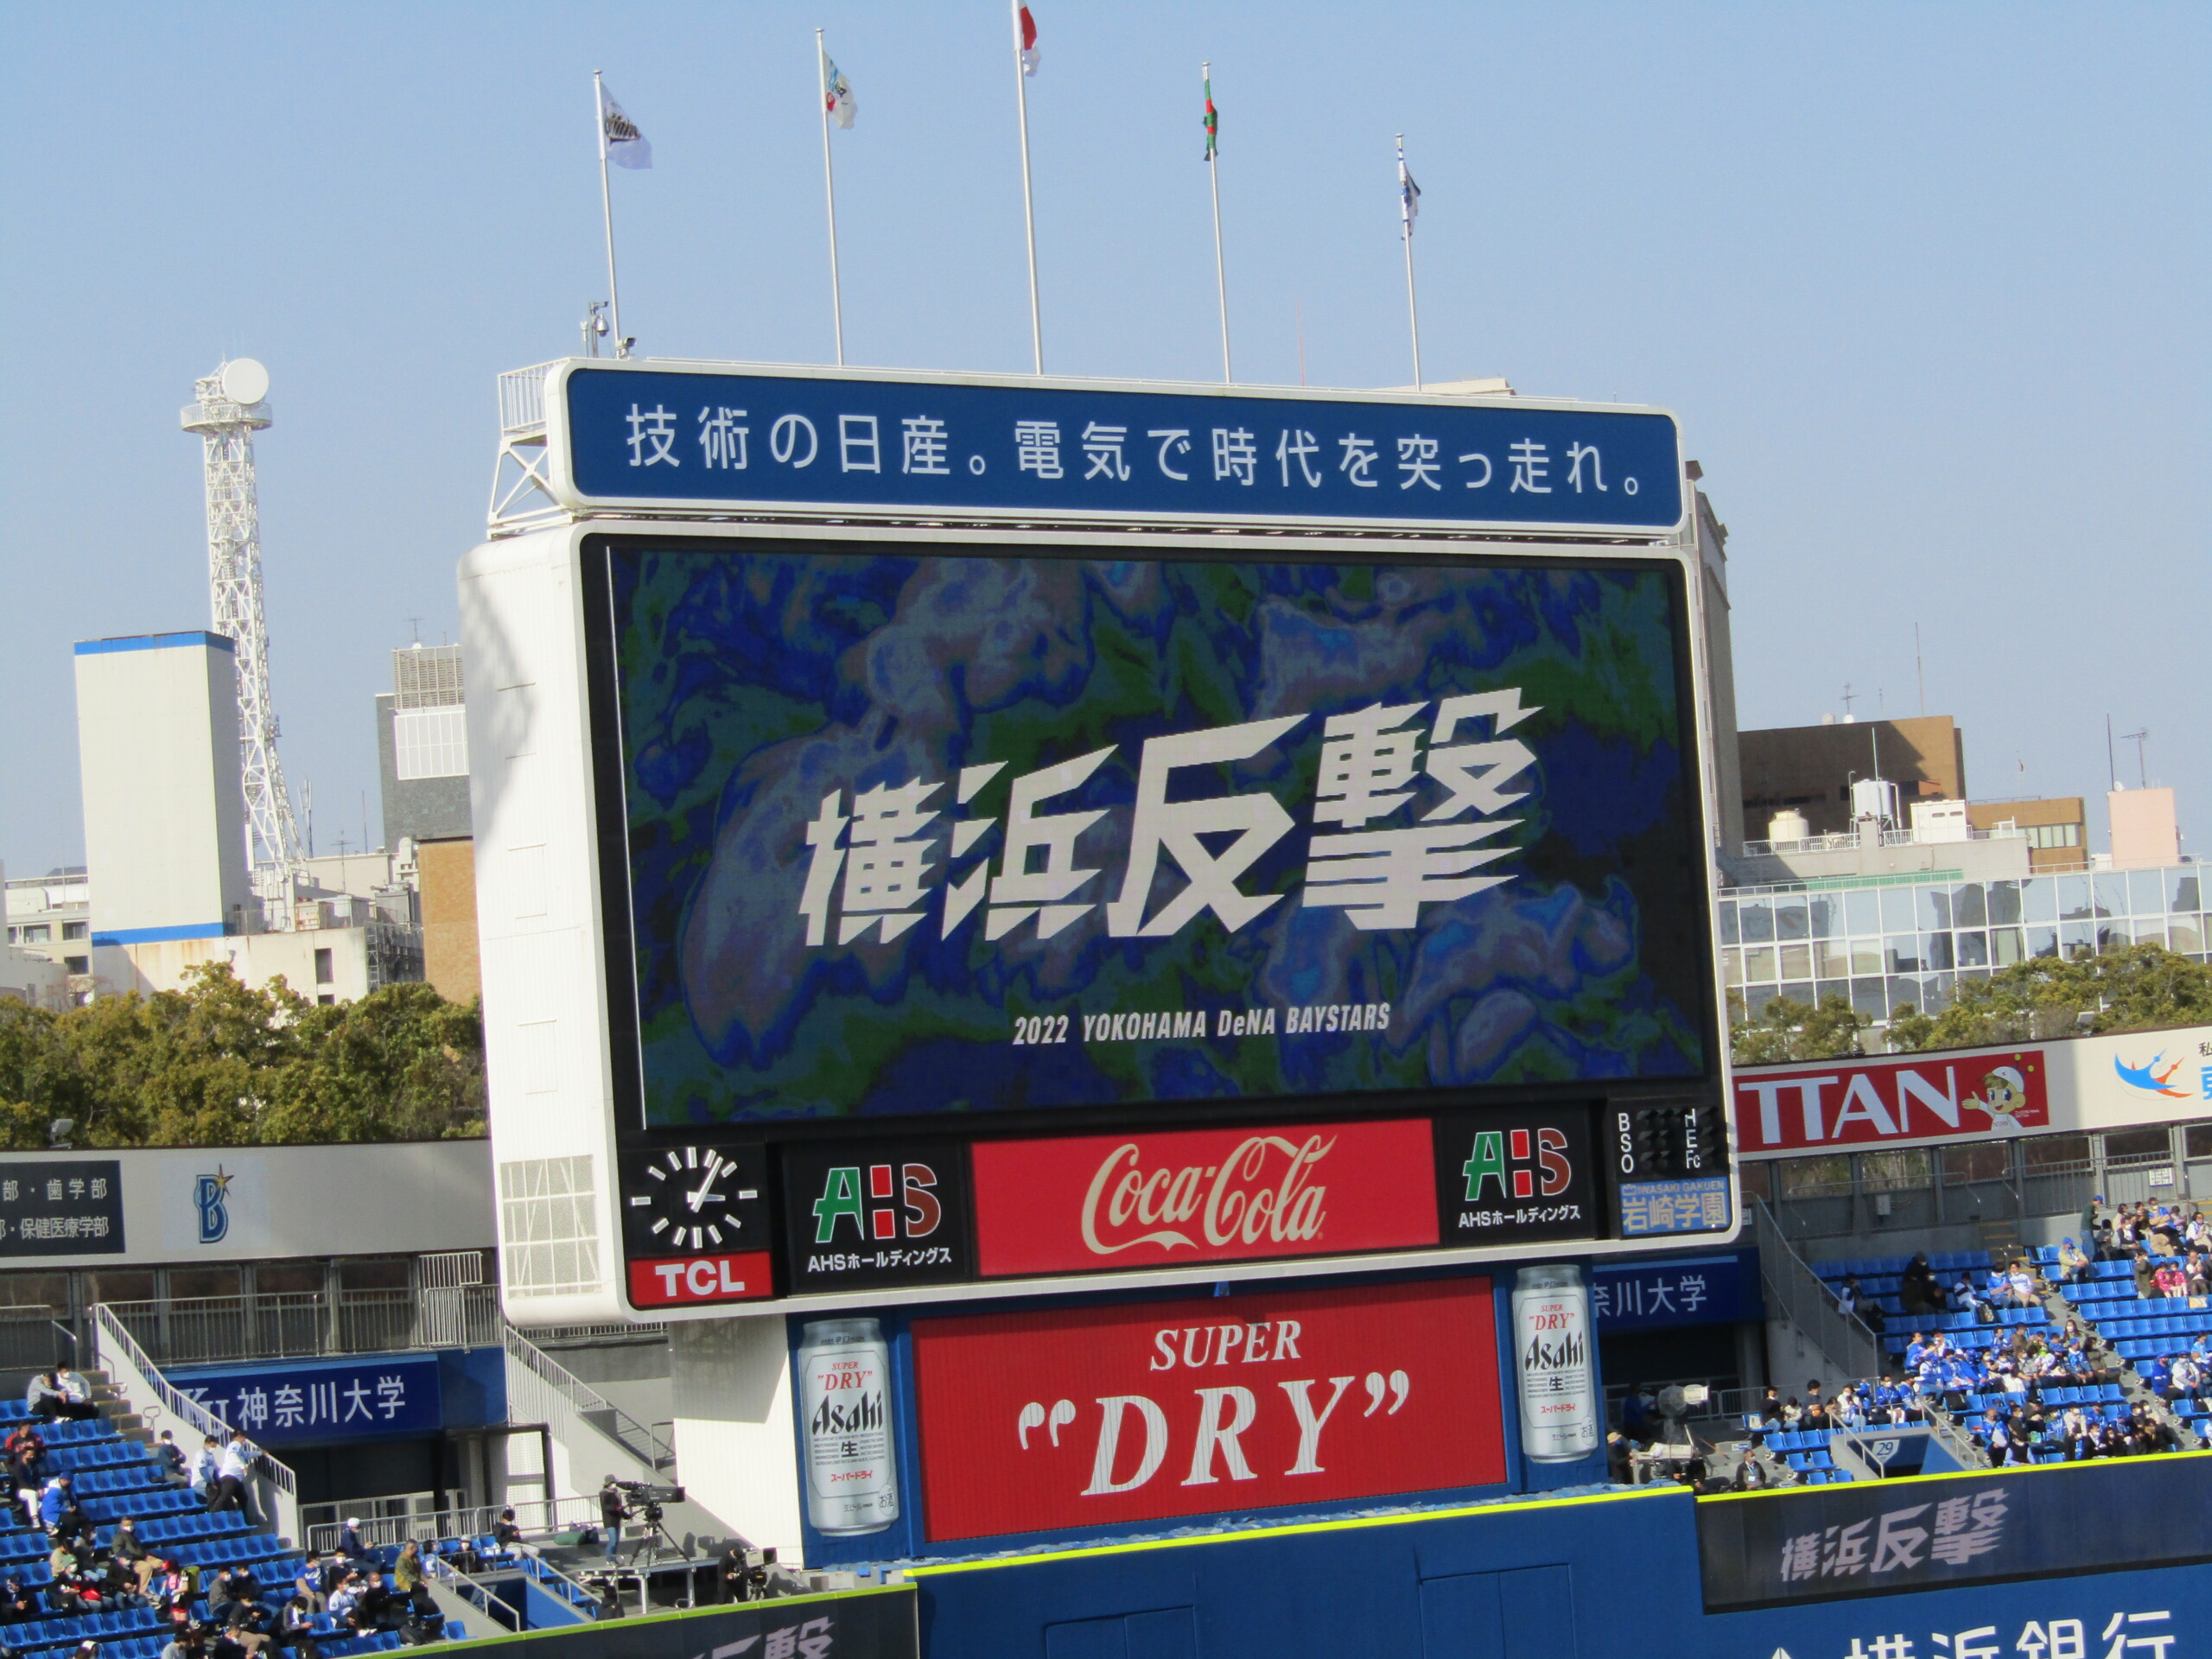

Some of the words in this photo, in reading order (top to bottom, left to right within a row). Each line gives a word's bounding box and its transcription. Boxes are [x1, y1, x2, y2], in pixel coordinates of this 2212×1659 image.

[626, 404, 1638, 496] 技術の日産。電気で時代を突っ走れ。
[799, 687, 1545, 947] 横浜反撃
[1013, 1015, 1069, 1045] 2022
[1083, 1010, 1206, 1042] YOKOHAMA
[1217, 1007, 1275, 1037] DeNA
[1286, 1002, 1391, 1034] BAYSTARS
[1618, 1112, 1630, 1132] B
[1620, 1133, 1632, 1153] S
[1686, 1129, 1698, 1148] E
[1082, 1134, 1338, 1255] Coca-Cola
[1682, 1180, 1725, 1192] GAKUEN
[1459, 1205, 1581, 1228] AHSホールディングス
[1622, 1192, 1727, 1231] 岩崎学園
[807, 1247, 952, 1273] AHSホールディングス
[655, 1260, 745, 1297] TCL
[1150, 1320, 1301, 1371] SUPER
[1525, 1331, 1584, 1371] Asahi
[832, 1361, 859, 1370] SUPER
[1549, 1376, 1564, 1391] 生
[237, 1376, 406, 1431] 神奈川大学
[812, 1389, 883, 1435] Asahi
[1541, 1403, 1576, 1414] スーパードライ
[841, 1440, 859, 1458] 生
[1876, 1441, 1894, 1456] 29
[831, 1470, 873, 1482] スーパードライ
[1781, 1487, 2010, 1582] 横浜反撃
